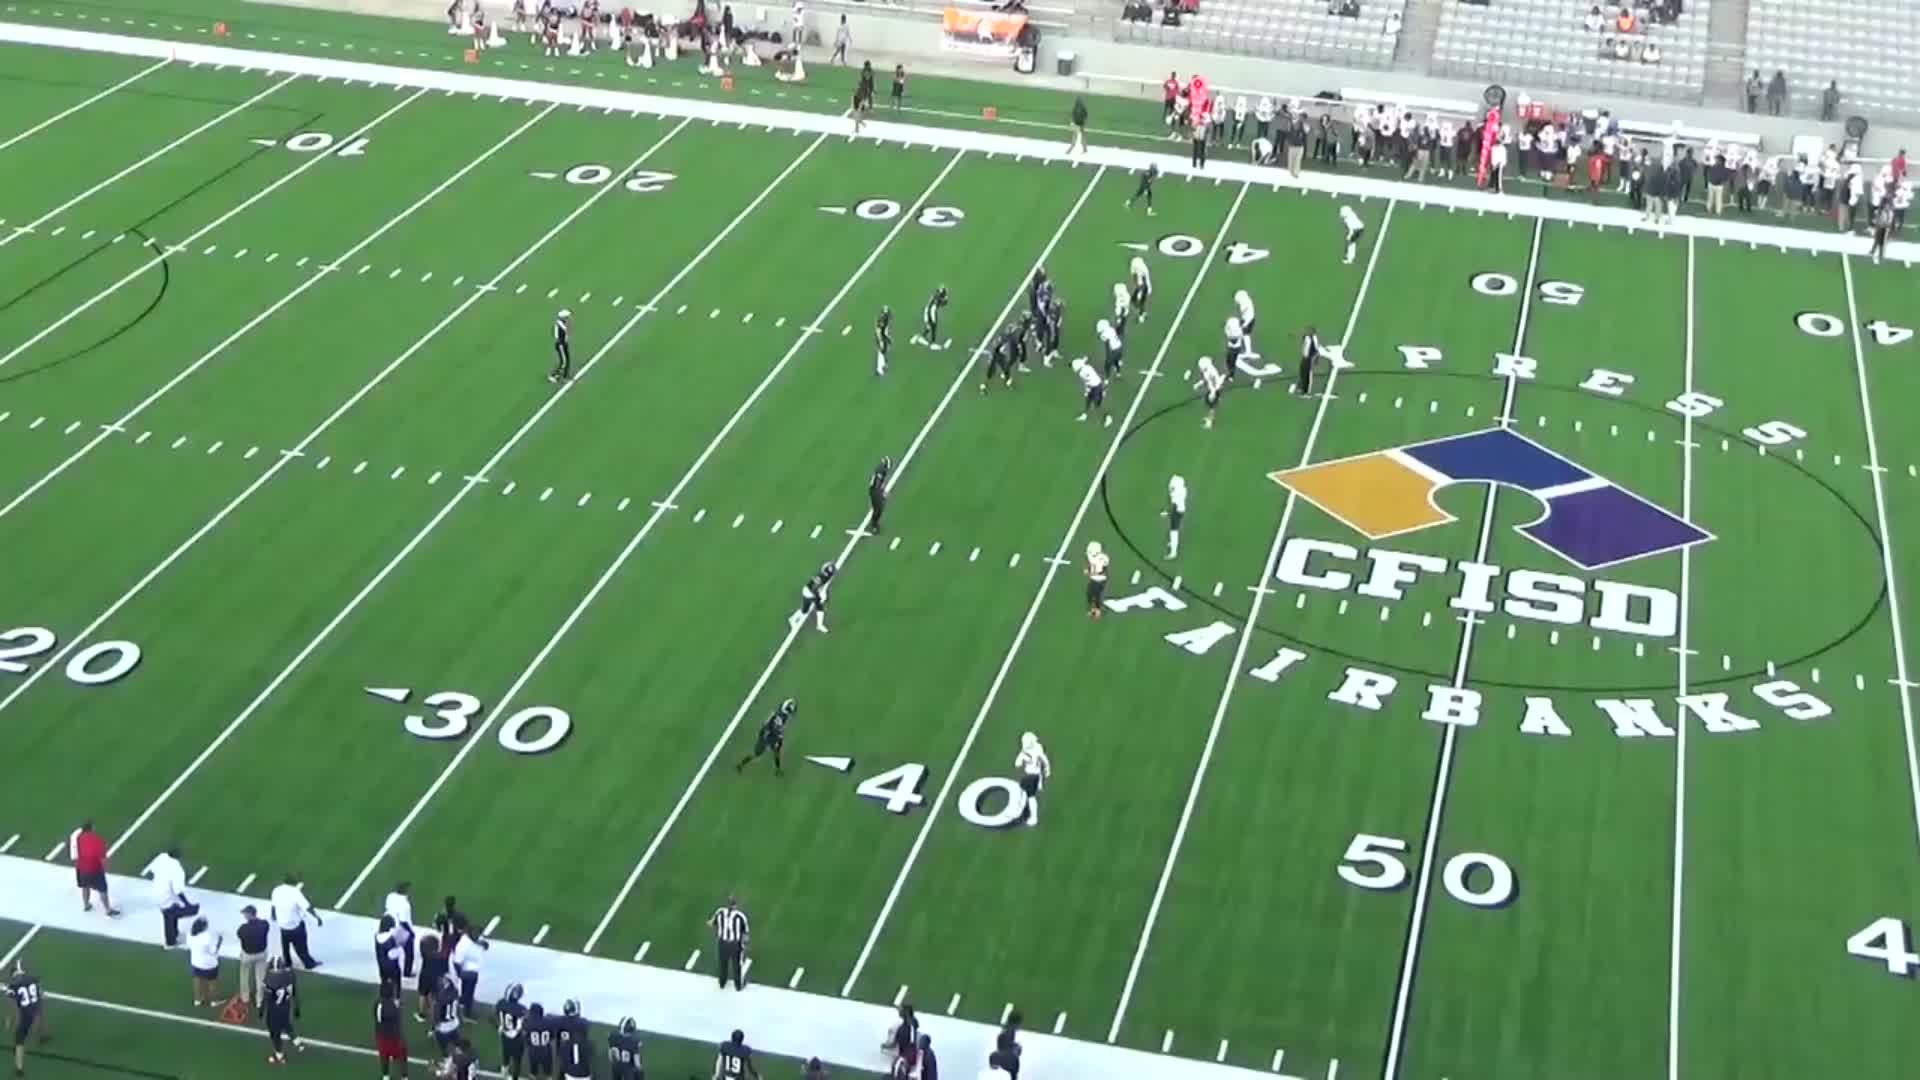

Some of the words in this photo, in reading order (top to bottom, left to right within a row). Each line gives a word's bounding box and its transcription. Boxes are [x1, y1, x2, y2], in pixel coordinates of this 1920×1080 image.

[286, 133, 369, 156] 10
[566, 165, 678, 191] 20
[856, 199, 965, 227] 30
[1159, 235, 1270, 264] 40
[1472, 273, 1585, 305] 50
[1798, 313, 1914, 344] 40
[1235, 344, 1807, 445] CYPRESS
[1276, 538, 1678, 637] CFISD
[0, 626, 141, 684] 20
[1103, 586, 1832, 737] FAIRBANKS
[404, 691, 571, 752] 30
[856, 763, 1027, 826] 40
[1337, 833, 1512, 905] 50
[725, 1055, 741, 1073] 19
